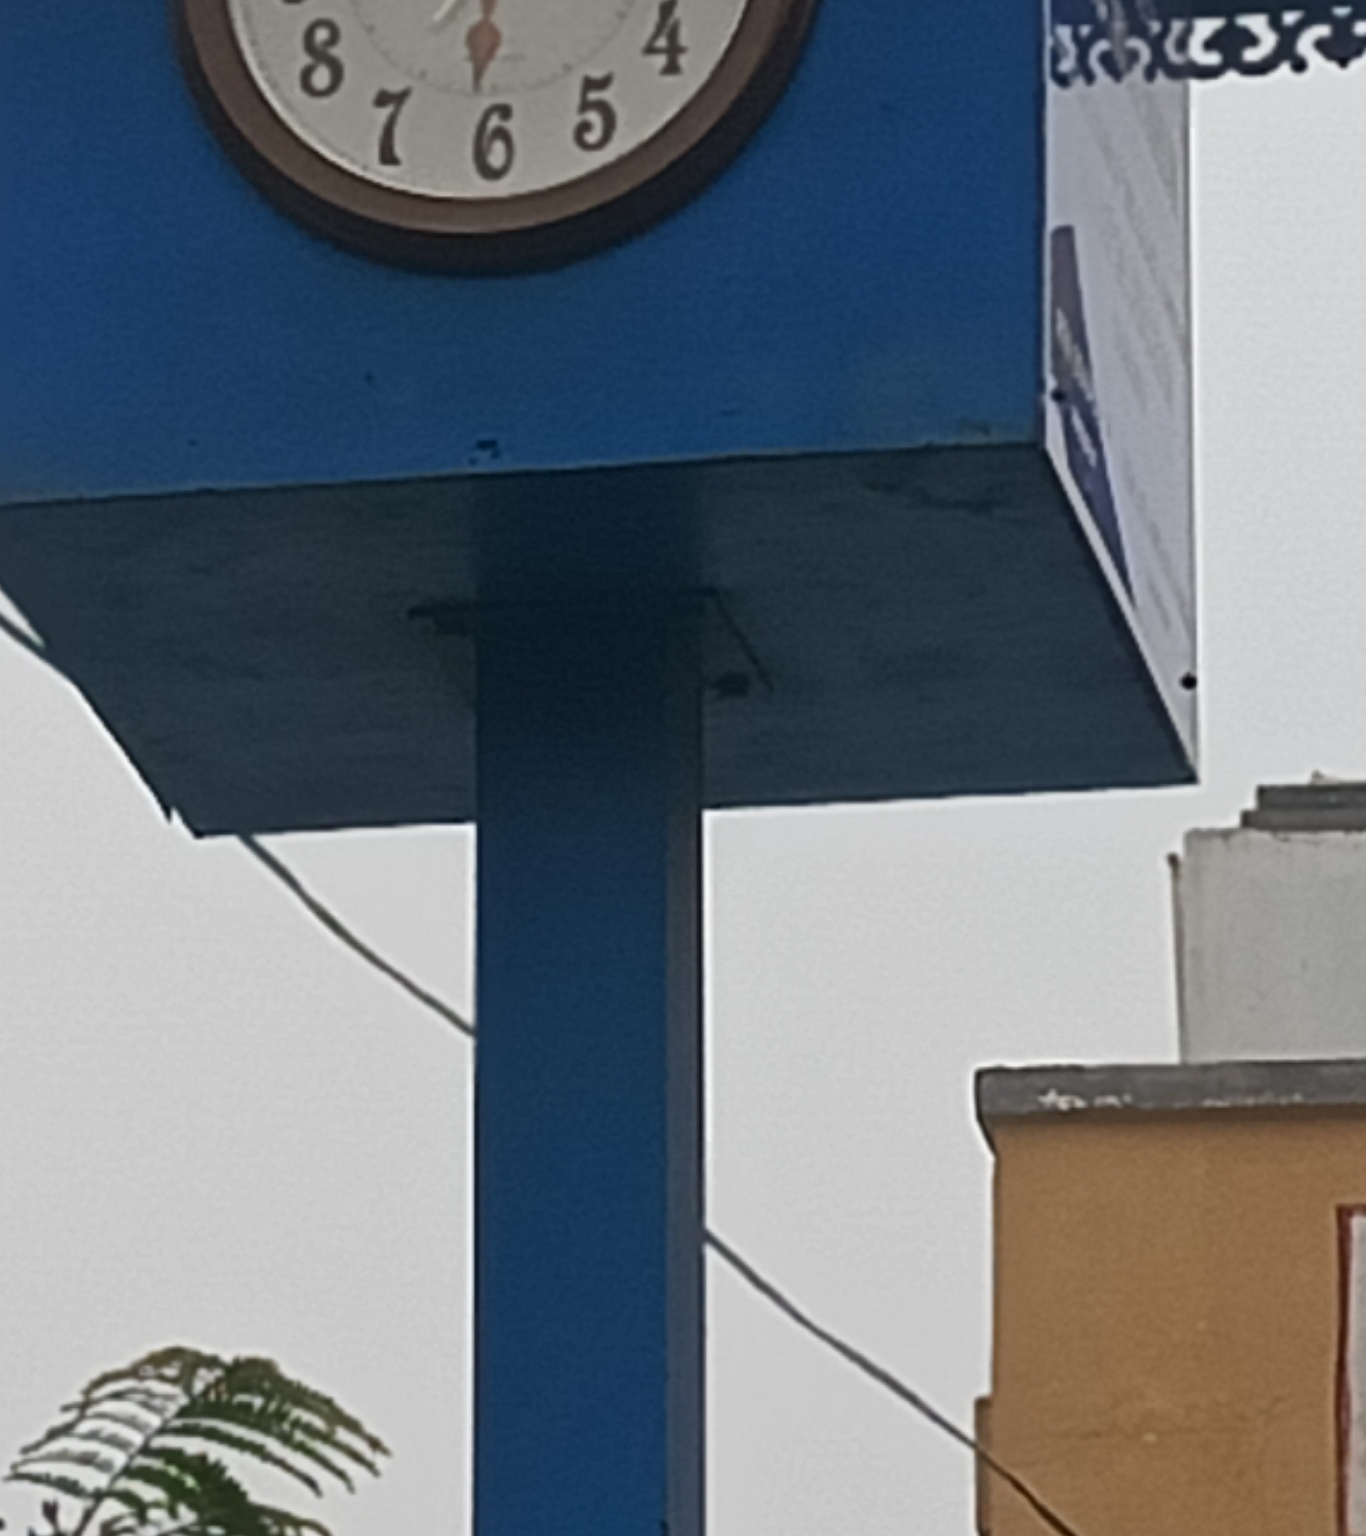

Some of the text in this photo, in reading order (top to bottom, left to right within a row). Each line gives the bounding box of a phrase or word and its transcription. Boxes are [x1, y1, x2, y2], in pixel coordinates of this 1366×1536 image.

[299, 18, 344, 98] 8
[373, 87, 412, 167] 7
[472, 104, 514, 182] 6
[574, 73, 617, 152] 5
